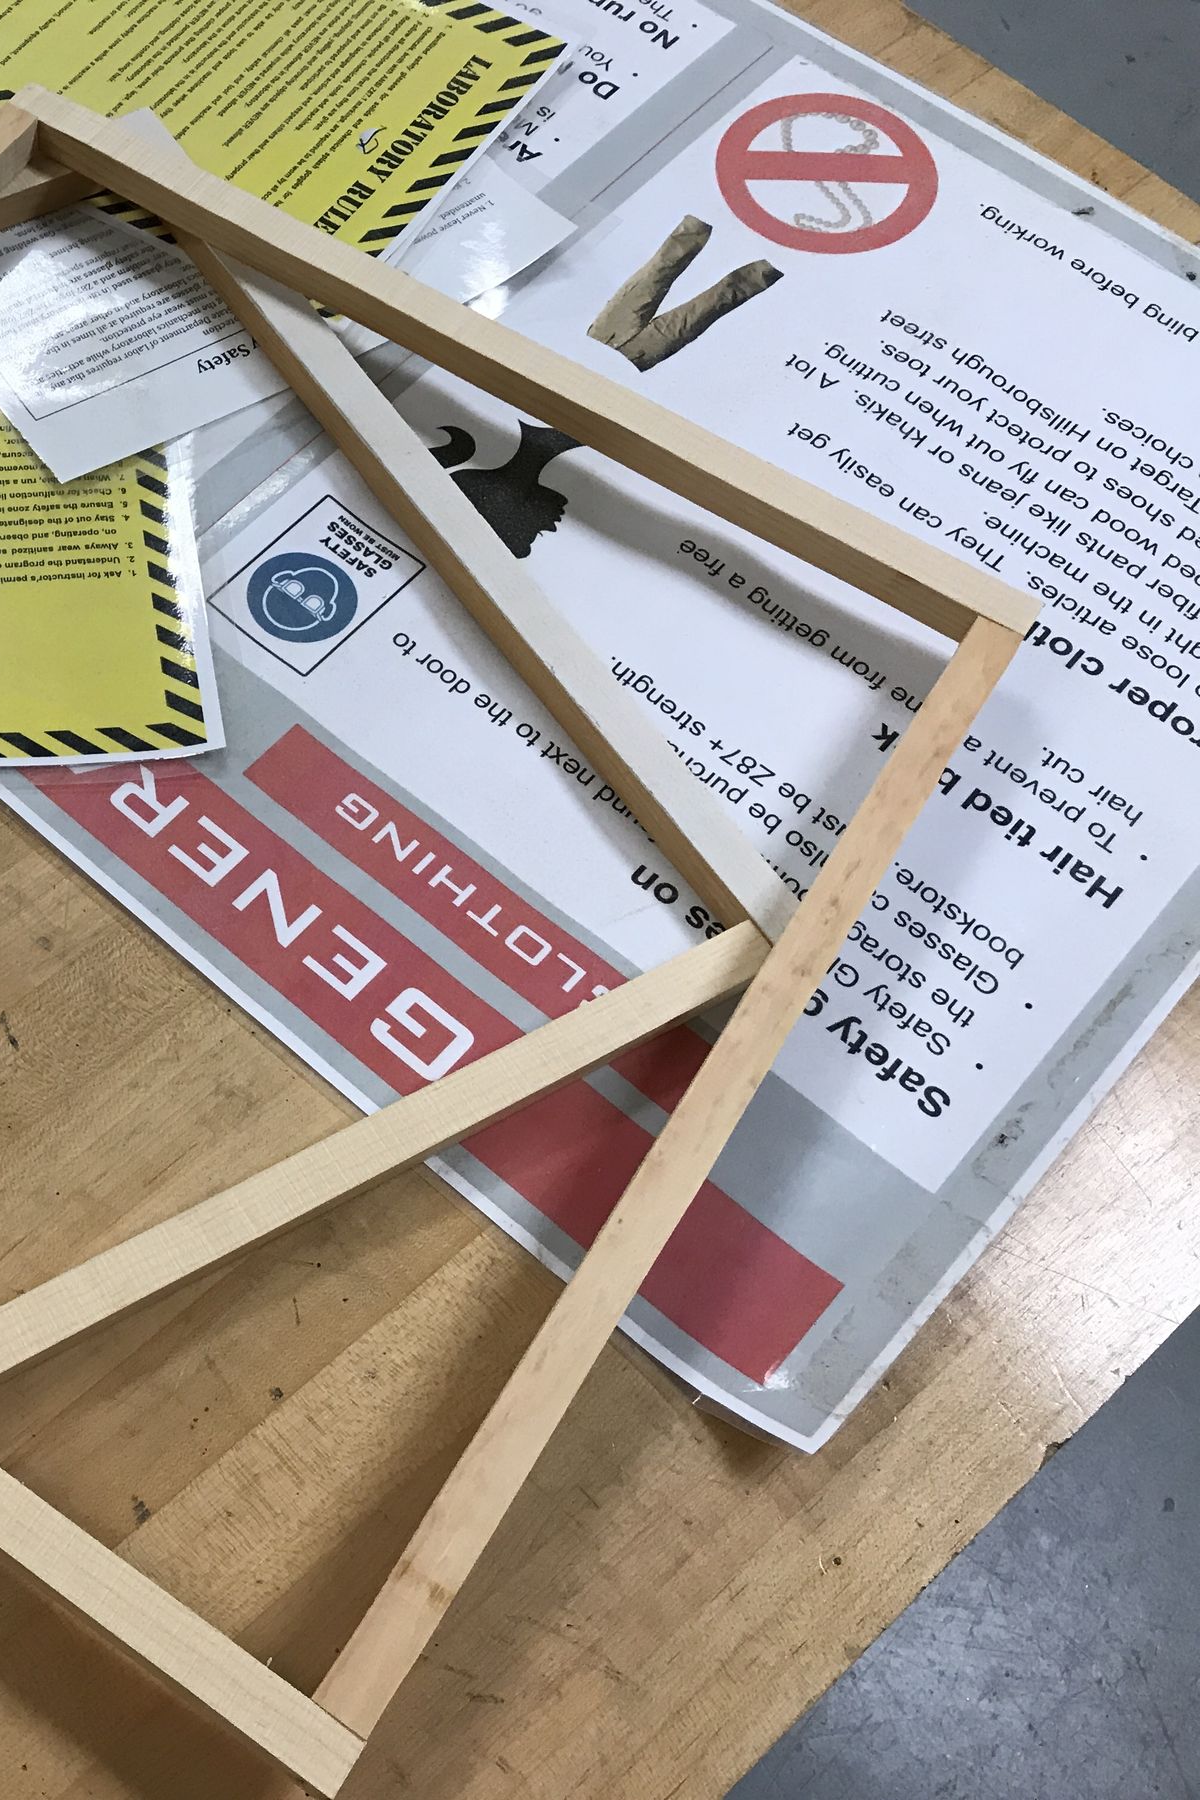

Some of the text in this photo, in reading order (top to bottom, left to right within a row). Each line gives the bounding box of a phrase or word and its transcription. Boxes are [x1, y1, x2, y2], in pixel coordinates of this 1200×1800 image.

[638, 19, 679, 49] No
[578, 71, 620, 100] Do
[365, 53, 491, 185] LABORATORY
[533, 102, 556, 124] is
[312, 177, 374, 236] RULE
[980, 203, 1064, 260] working.
[1070, 258, 1139, 308] before
[84, 306, 201, 364] mechanics laboratory while
[97, 317, 147, 345] protection.
[117, 300, 156, 324] required
[84, 313, 211, 376] Department Labor requires
[193, 340, 249, 377] Safety
[824, 342, 900, 391] cutting.
[873, 335, 933, 380] toes.
[880, 309, 1200, 515] Target on Hillsborough street
[904, 390, 963, 436] when
[928, 367, 989, 415] your
[965, 433, 1005, 462] out
[982, 404, 1071, 469] protect
[1102, 408, 1193, 468] choices.
[781, 351, 1200, 621] fiber pants like jeans or khakis. A lot
[1007, 461, 1039, 484] fly
[1068, 455, 1100, 484] to
[32, 500, 112, 511] Ensure safety
[1043, 479, 1088, 509] can
[1102, 477, 1175, 526] shoes
[11, 545, 53, 554] sanitized
[51, 528, 99, 538] operating,
[84, 541, 118, 551] Always
[323, 517, 395, 573] GLASSES
[336, 512, 401, 562] MUST BE WORN
[787, 422, 1190, 688] loose articles. They can easily get
[983, 511, 1089, 583] machine.
[1090, 508, 1157, 556] wood
[4, 559, 44, 569] program
[30, 571, 84, 582] instructor's
[65, 555, 120, 565] Understand
[103, 569, 121, 578] Ask
[316, 531, 379, 580] SAFETY
[676, 540, 725, 576] free
[728, 572, 745, 588] a
[1092, 582, 1132, 613] the
[747, 586, 829, 646] getting
[1138, 609, 1162, 633] in
[387, 629, 417, 658] to
[412, 648, 472, 700] door
[830, 645, 885, 689] from
[473, 693, 512, 726] the
[611, 656, 705, 736] strength.
[515, 723, 540, 746] to
[539, 740, 595, 786] next
[709, 739, 775, 787] Z87+
[982, 749, 1086, 822] prevent
[778, 782, 811, 814] be
[1041, 747, 1143, 827] hair cut.
[748, 802, 782, 835] be
[960, 787, 1036, 846] tied
[1087, 822, 1116, 853] To
[630, 864, 678, 904] on
[1039, 845, 1123, 908] Hair
[107, 762, 478, 1083] GENER
[894, 861, 1024, 970] bookstore.
[846, 920, 926, 988] storag
[893, 910, 998, 994] Glasses
[862, 984, 950, 1055] Safety
[931, 988, 974, 1027] the
[825, 1016, 950, 1117] Safety
